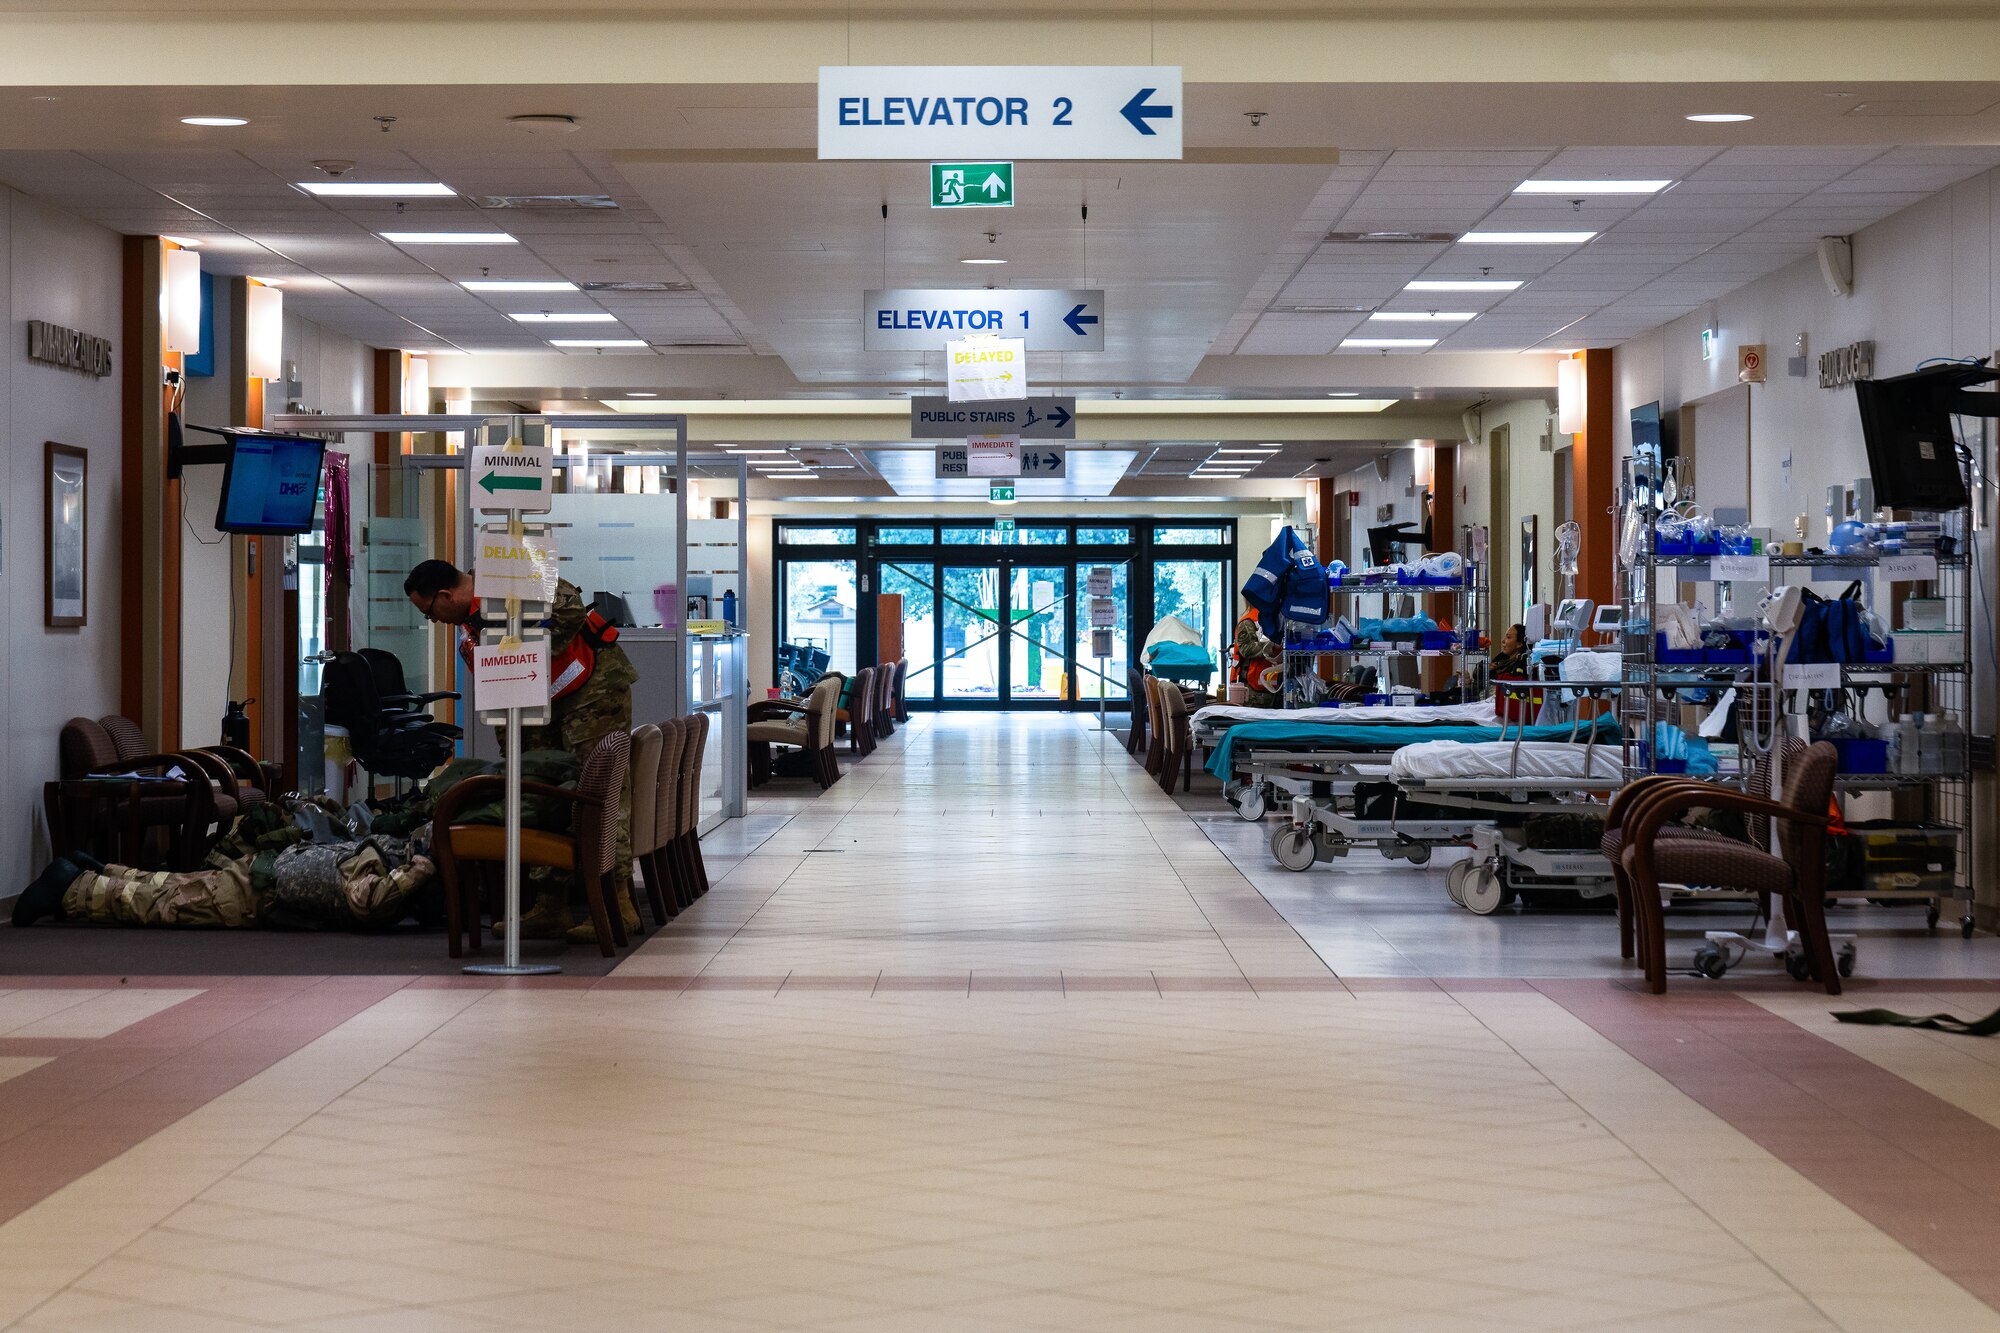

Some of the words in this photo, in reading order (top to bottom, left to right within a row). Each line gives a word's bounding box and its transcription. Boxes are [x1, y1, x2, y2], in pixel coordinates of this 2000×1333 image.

[838, 97, 1028, 126] ELEVATOR
[1052, 97, 1073, 126] 2
[877, 310, 1003, 330] ELEVATOR
[1019, 310, 1029, 329] 1
[955, 351, 1013, 364] DELAYED
[920, 411, 966, 423] PUBLIC
[969, 411, 1015, 423] STAIRS
[971, 441, 1014, 449] IMMEDIATE
[942, 451, 967, 460] PUBL
[484, 456, 542, 468] MINIMAL
[942, 463, 967, 472] REST
[481, 653, 537, 667] IMMEDIATE
